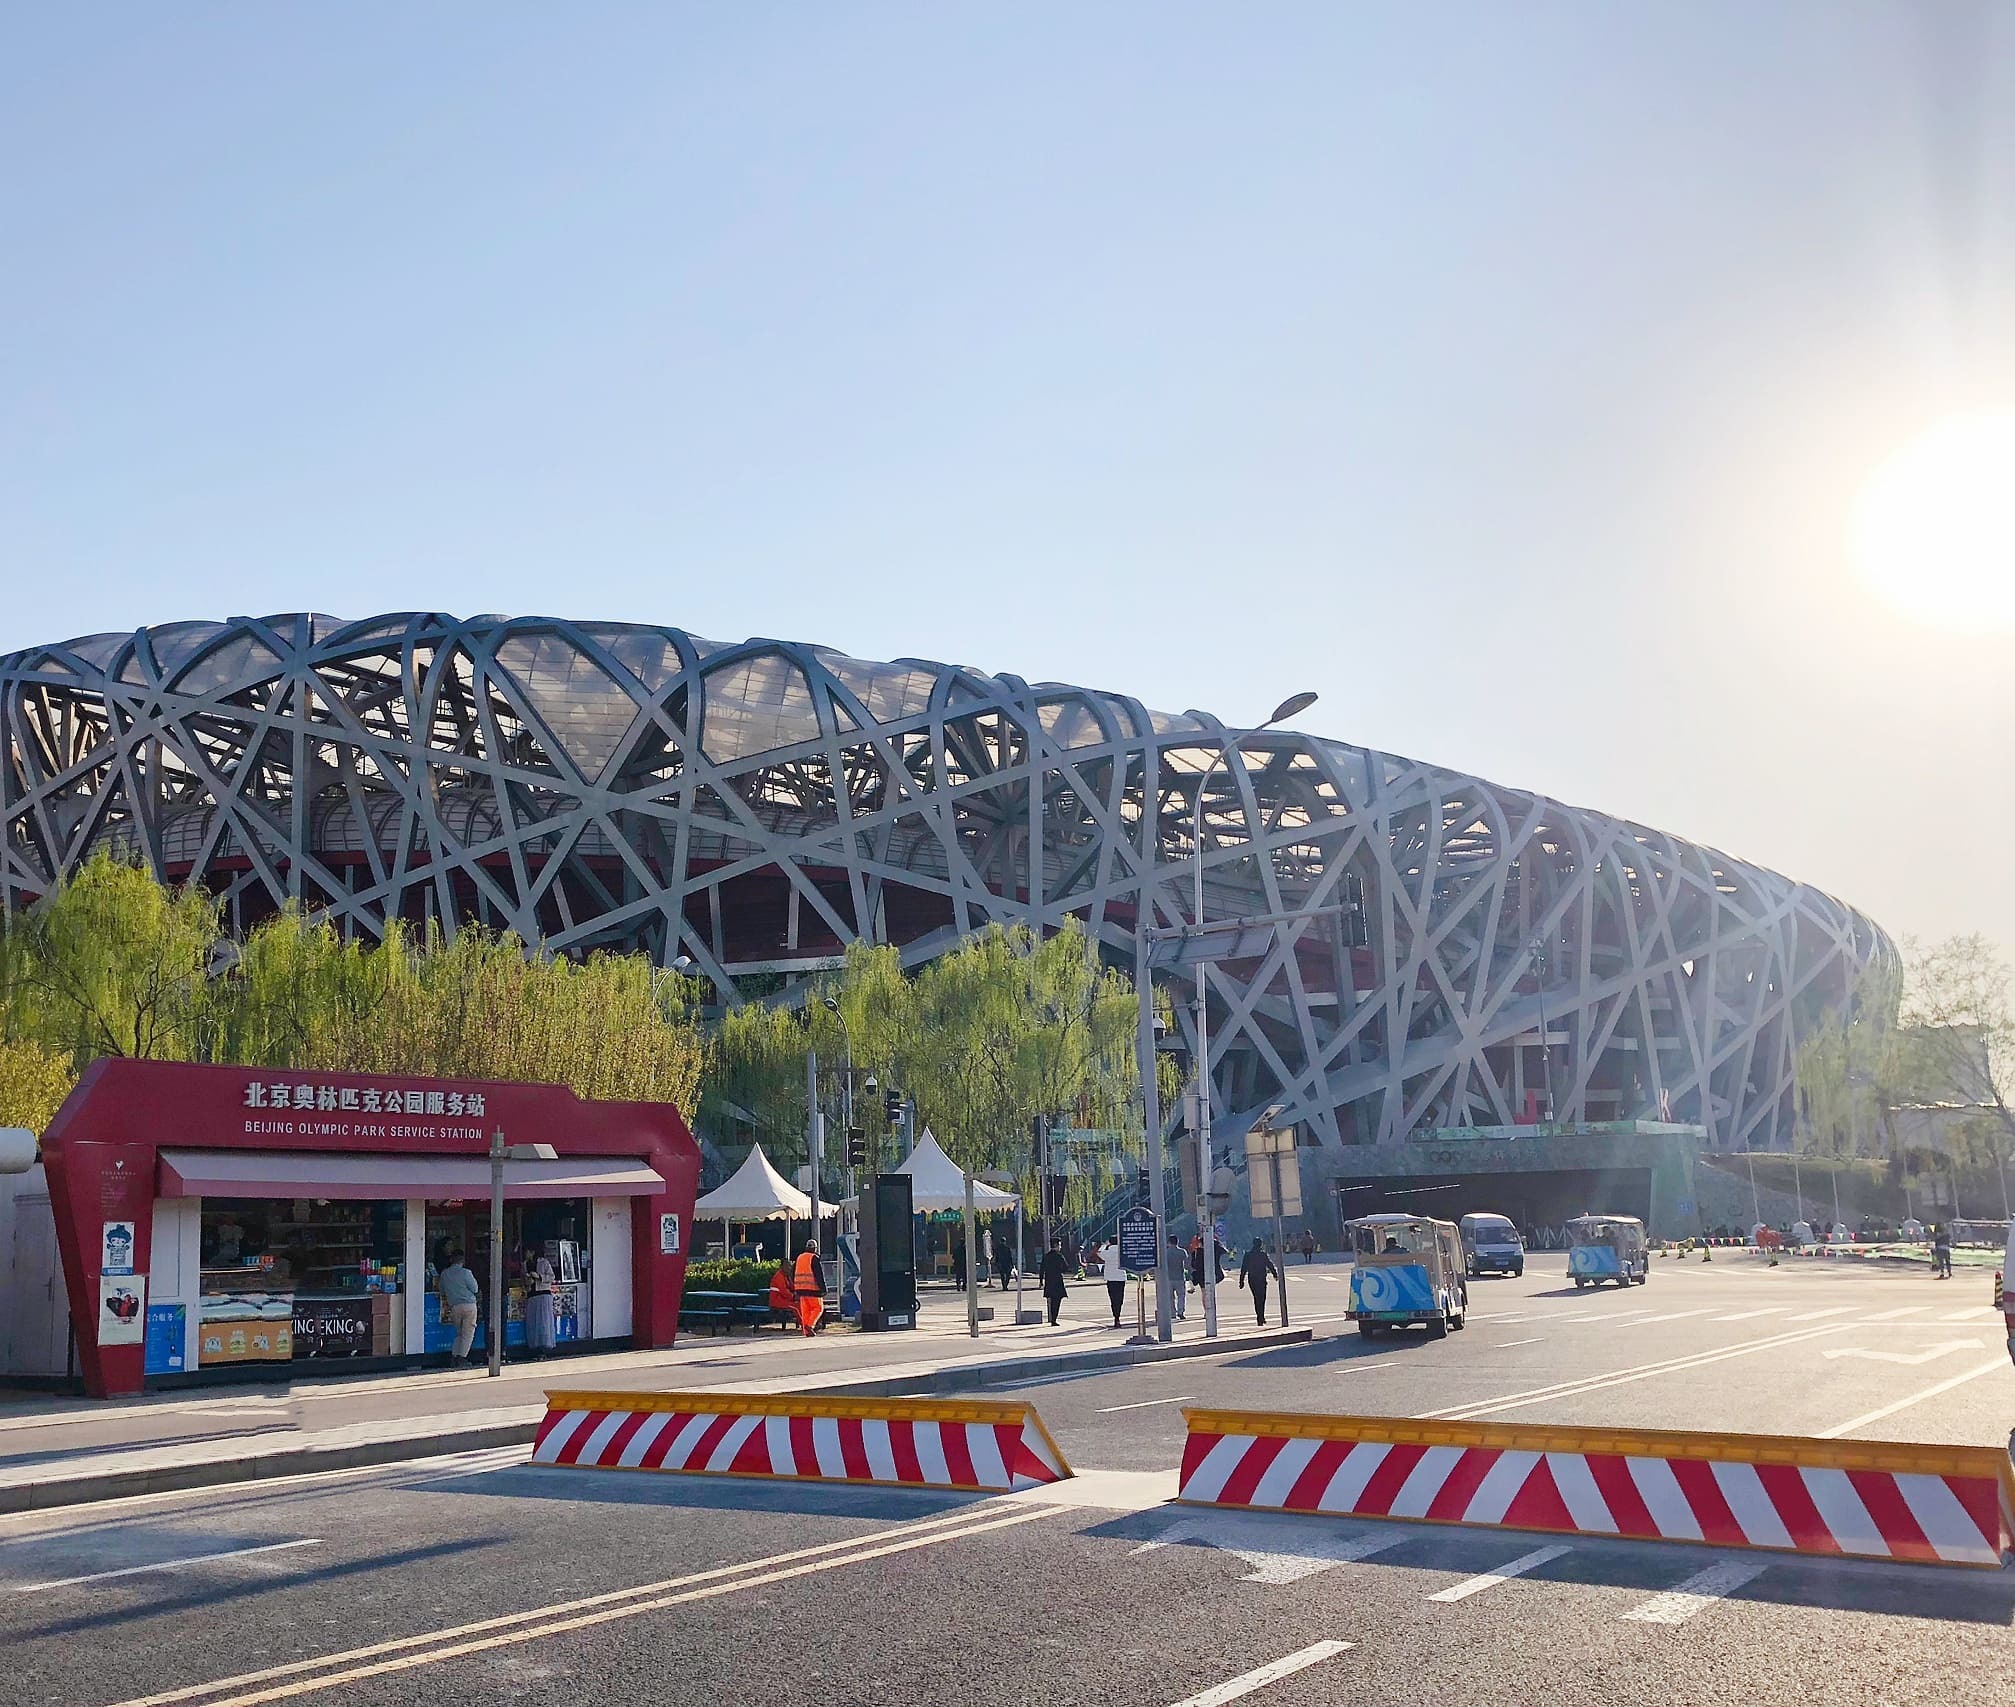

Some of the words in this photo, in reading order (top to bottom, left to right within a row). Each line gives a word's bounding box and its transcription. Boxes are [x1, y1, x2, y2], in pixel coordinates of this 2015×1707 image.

[244, 1081, 486, 1117] 北京奥林匹克公园服务站
[244, 1120, 294, 1134] BEIJING
[298, 1122, 349, 1136] OLYMPIC
[354, 1124, 386, 1137] PARK
[390, 1126, 436, 1138] SERVICE
[439, 1127, 483, 1140] STATION
